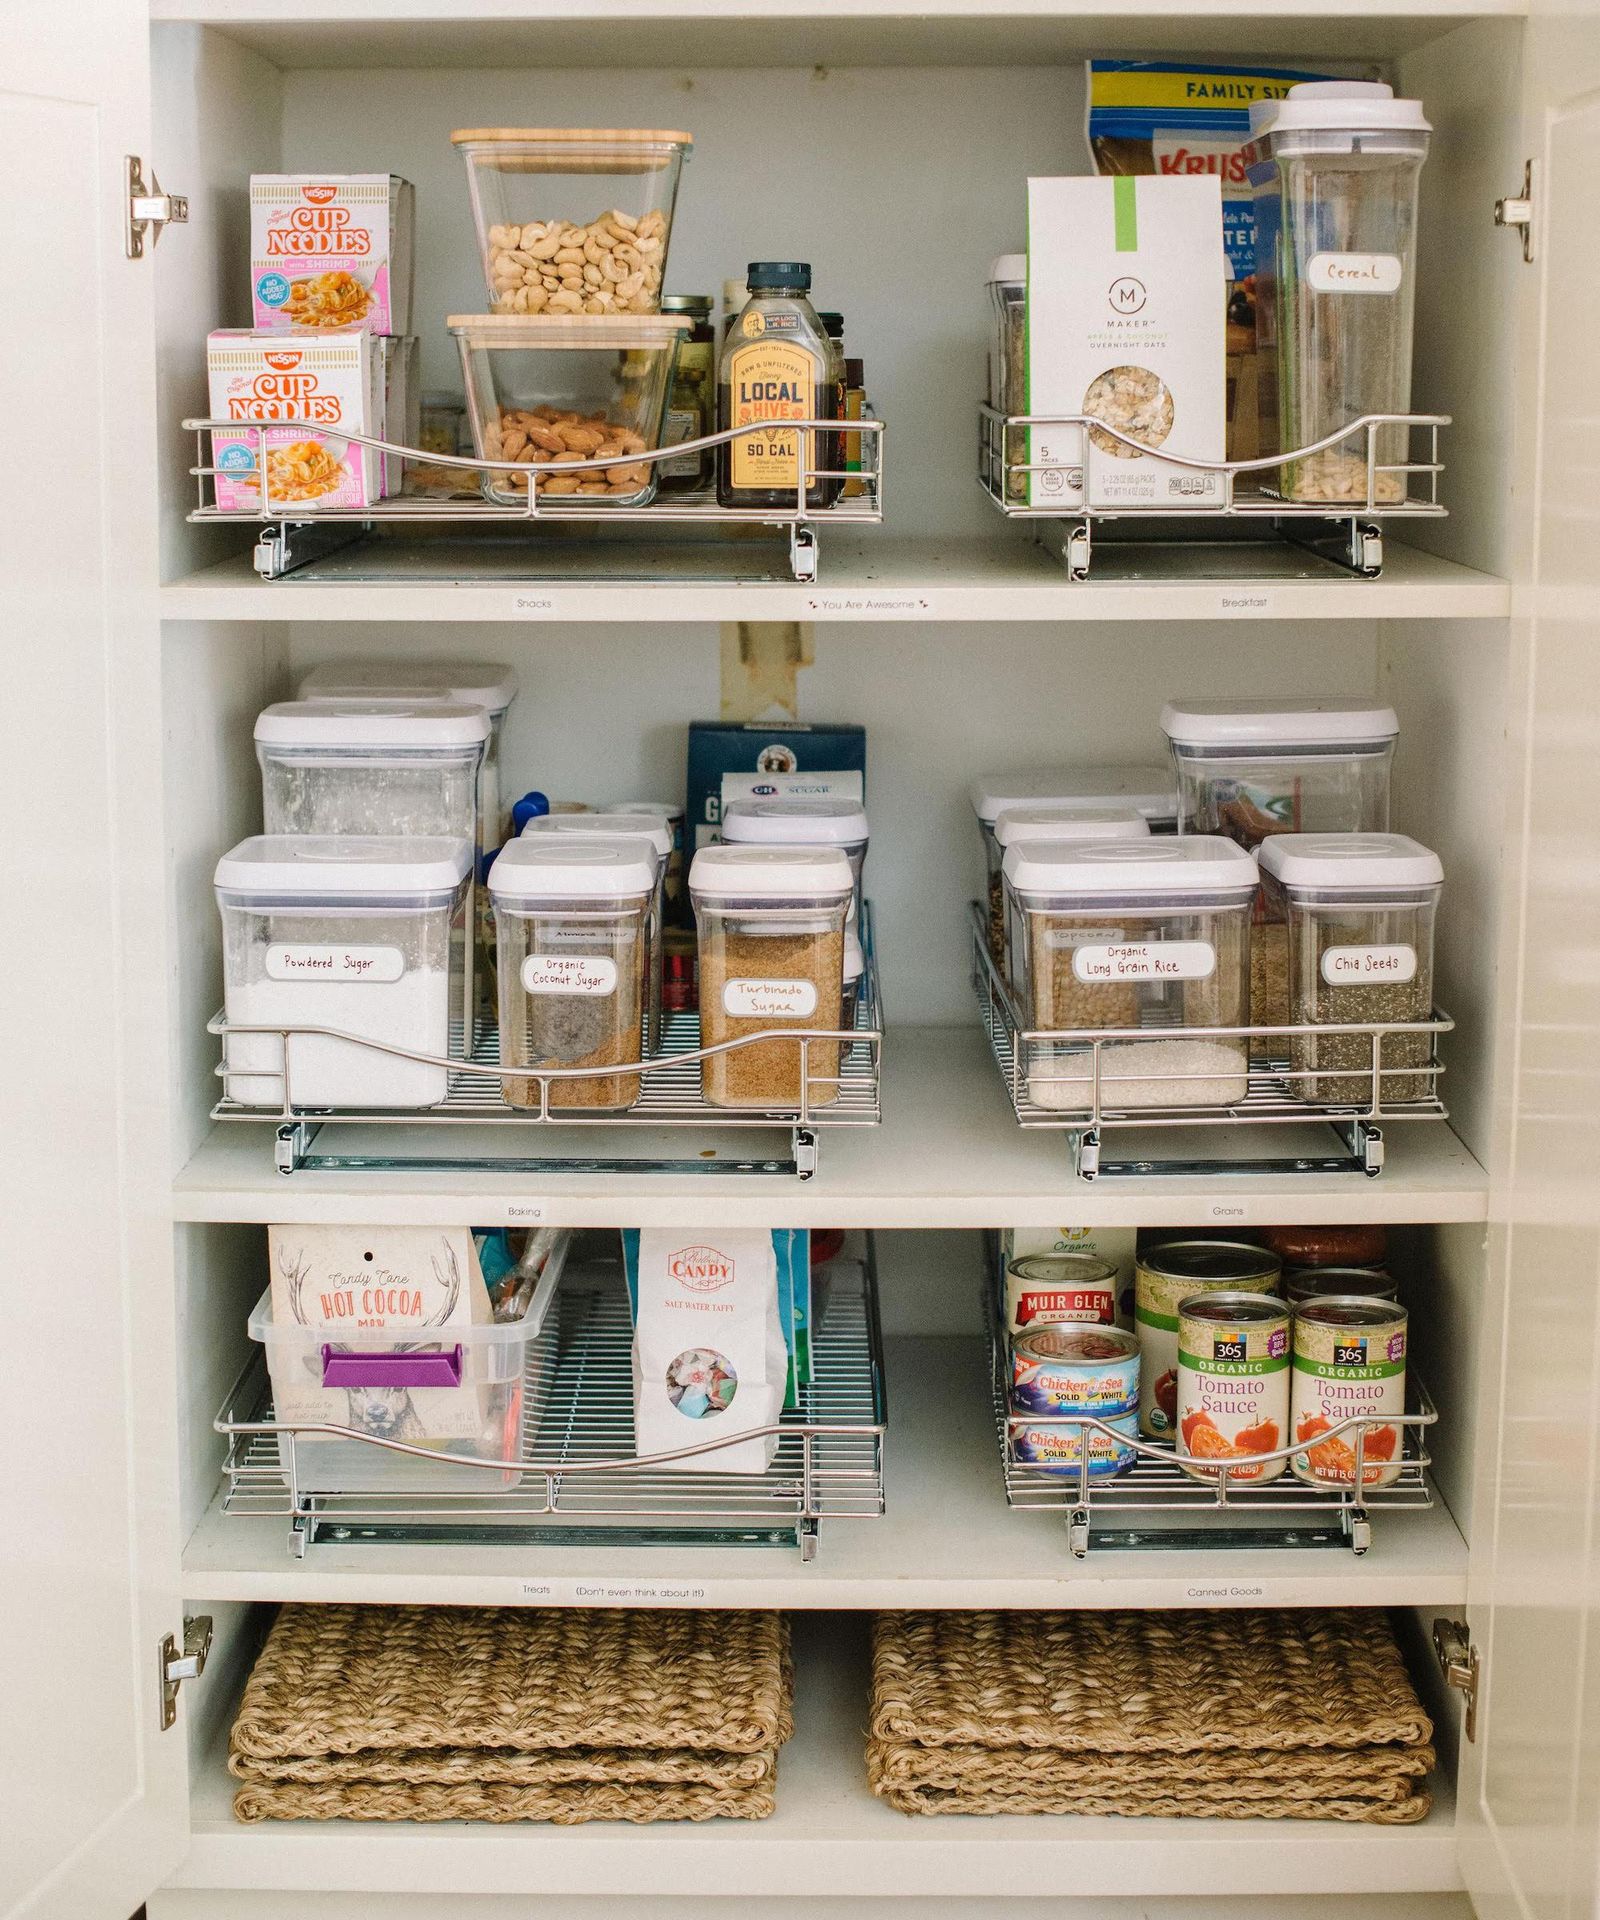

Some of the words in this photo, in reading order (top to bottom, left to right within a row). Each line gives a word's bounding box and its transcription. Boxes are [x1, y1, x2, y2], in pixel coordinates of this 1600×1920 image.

[1186, 82, 1255, 99] FAMILY
[1262, 86, 1291, 100] SIZ
[1158, 147, 1247, 183] KRUS
[305, 188, 334, 199] NISSIN
[291, 206, 350, 232] CUP
[267, 229, 370, 255] NOODLES
[306, 260, 350, 268] SHRIMP
[1328, 263, 1380, 280] Cereal
[262, 284, 285, 295] ADDED
[266, 279, 277, 287] NO
[267, 353, 299, 365] NISSIN
[741, 365, 755, 376] RAW
[762, 360, 802, 376] UNFILTERED
[253, 373, 318, 400] CUP
[740, 382, 804, 403] LOCAL
[228, 396, 341, 424] NOODLES
[753, 402, 790, 418] HIVE
[747, 444, 764, 456] SO
[769, 444, 795, 456] CAL
[1041, 446, 1049, 457] 5
[517, 599, 552, 608] Snacks
[822, 600, 842, 609] You
[845, 600, 862, 609] Are
[865, 600, 915, 609] Awesome
[1222, 598, 1267, 608] Breakfast
[1108, 946, 1148, 960] Organic
[284, 954, 333, 968] Powdered
[344, 955, 374, 974] Sugar
[546, 959, 585, 974] Organic
[1086, 962, 1110, 976] Long
[1117, 960, 1149, 973] Grain
[1154, 960, 1180, 973] Rice
[1335, 957, 1359, 970] Chia
[1365, 955, 1399, 971] Seeds
[532, 972, 571, 985] Coconut
[575, 973, 605, 990] Sugar
[737, 983, 803, 995] Turbinado
[508, 1206, 541, 1217] Baking
[1212, 1206, 1244, 1215] Grains
[1053, 1241, 1097, 1253] Organic
[672, 1260, 730, 1278] CANDY
[328, 1272, 372, 1289] Candy
[375, 1269, 409, 1286] Cane
[320, 1290, 354, 1320] HOT
[362, 1288, 422, 1317] COCOA
[664, 1301, 684, 1309] SALT
[685, 1302, 710, 1311] WATER
[712, 1304, 735, 1312] TAFFY
[1027, 1295, 1066, 1311] MUIR
[1074, 1294, 1108, 1310] GLEN
[1217, 1343, 1242, 1358] 365
[1338, 1347, 1362, 1362] 365
[1199, 1360, 1263, 1373] ORGANIC
[1318, 1365, 1383, 1378] ORGANIC
[1040, 1376, 1088, 1393] Chicken
[1105, 1378, 1123, 1390] Sea
[1195, 1374, 1265, 1395] Tomato
[1314, 1379, 1384, 1400] Tomato
[1055, 1392, 1080, 1401] SOLID
[1101, 1391, 1122, 1400] WHITE
[1202, 1395, 1257, 1414] Sauce
[1321, 1400, 1377, 1418] Sauce
[1029, 1432, 1075, 1450] Chicken
[1093, 1436, 1112, 1448] Sea
[1043, 1448, 1067, 1458] SOLID
[1088, 1449, 1113, 1458] WHITE
[1314, 1466, 1326, 1476] NET
[1328, 1468, 1337, 1478] WT
[522, 1584, 551, 1594] Treats
[575, 1586, 605, 1597] (Don't
[607, 1588, 632, 1597] even
[634, 1588, 657, 1597] think
[660, 1588, 690, 1598] about
[1187, 1587, 1228, 1597] Canned
[1230, 1586, 1263, 1596] Goods
